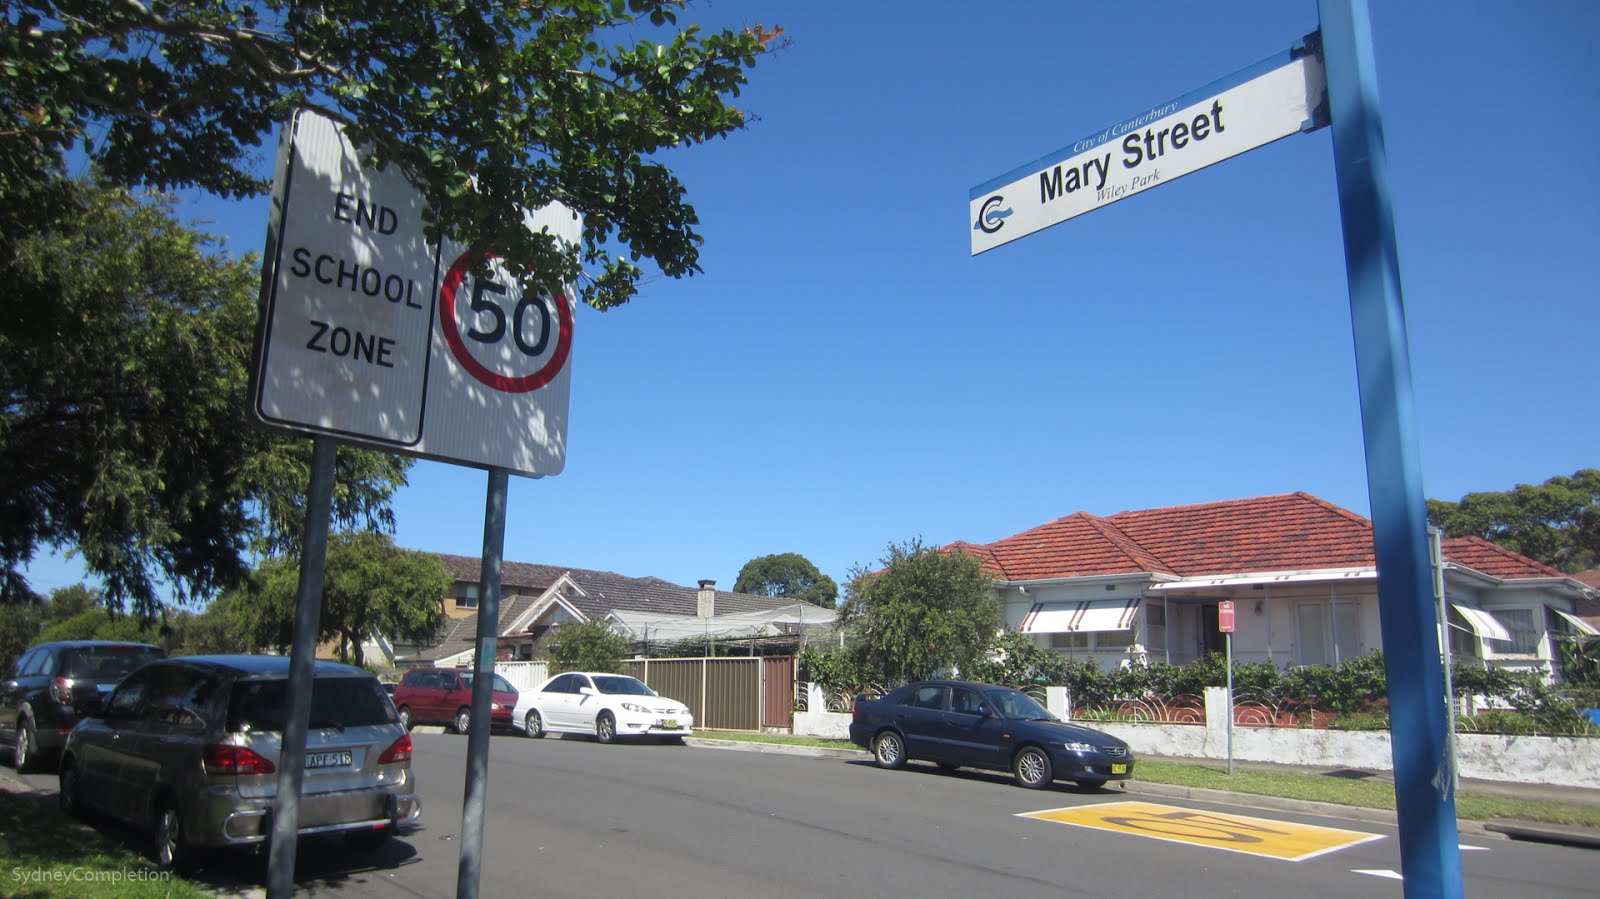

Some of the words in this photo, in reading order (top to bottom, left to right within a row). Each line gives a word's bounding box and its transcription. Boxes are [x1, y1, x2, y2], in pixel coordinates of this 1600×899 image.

[1039, 152, 1111, 204] Mary
[1122, 99, 1226, 169] Street
[1072, 138, 1096, 154] City
[1098, 128, 1111, 143] of
[1111, 101, 1179, 138] Canterbury
[1096, 183, 1128, 204] Wiley
[1131, 167, 1161, 192] Park
[334, 193, 398, 235] END
[289, 247, 423, 310] SCHOOL
[306, 319, 396, 369] ZONE
[467, 279, 551, 357] 50
